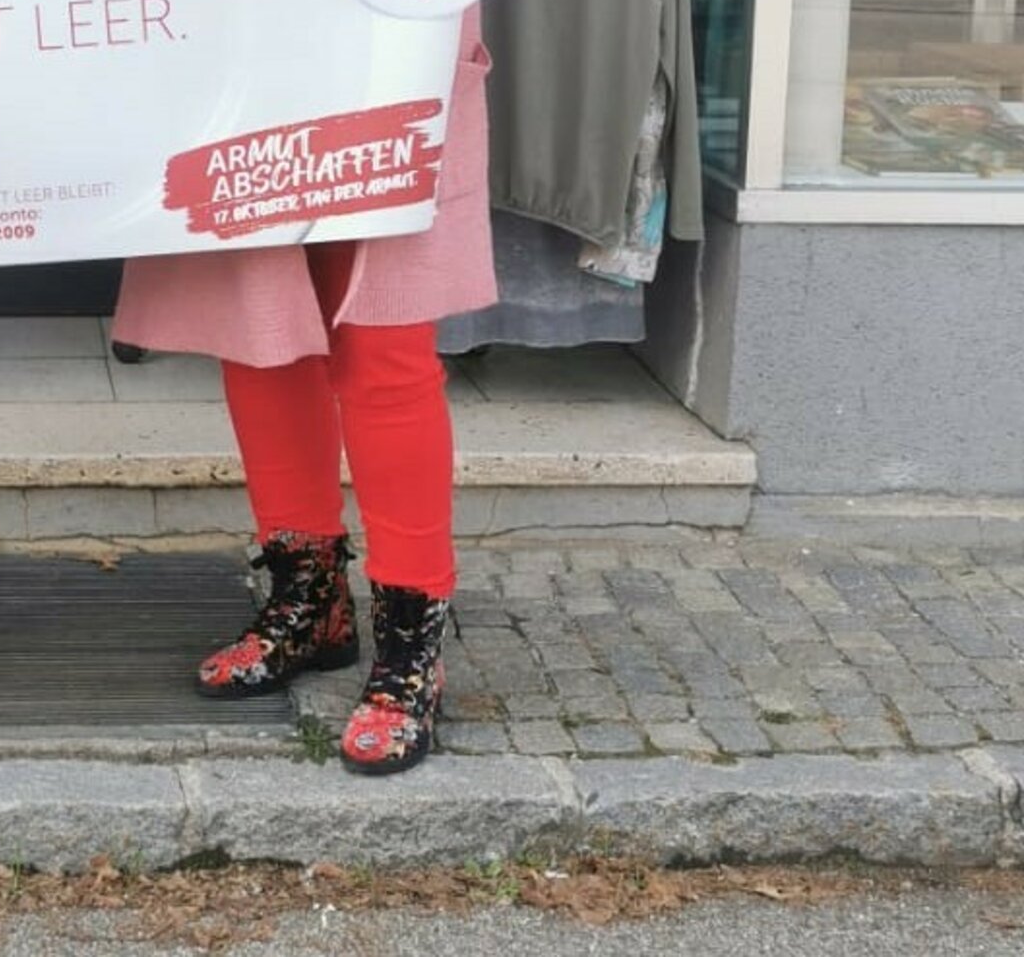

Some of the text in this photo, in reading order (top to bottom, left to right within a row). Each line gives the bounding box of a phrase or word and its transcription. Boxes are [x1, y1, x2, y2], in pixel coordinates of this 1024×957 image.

[205, 125, 323, 177] ARMUT
[211, 133, 416, 203] ABSCHAFFEN
[13, 186, 54, 204] LEER
[301, 188, 332, 209] TAG
[333, 181, 366, 203] DER
